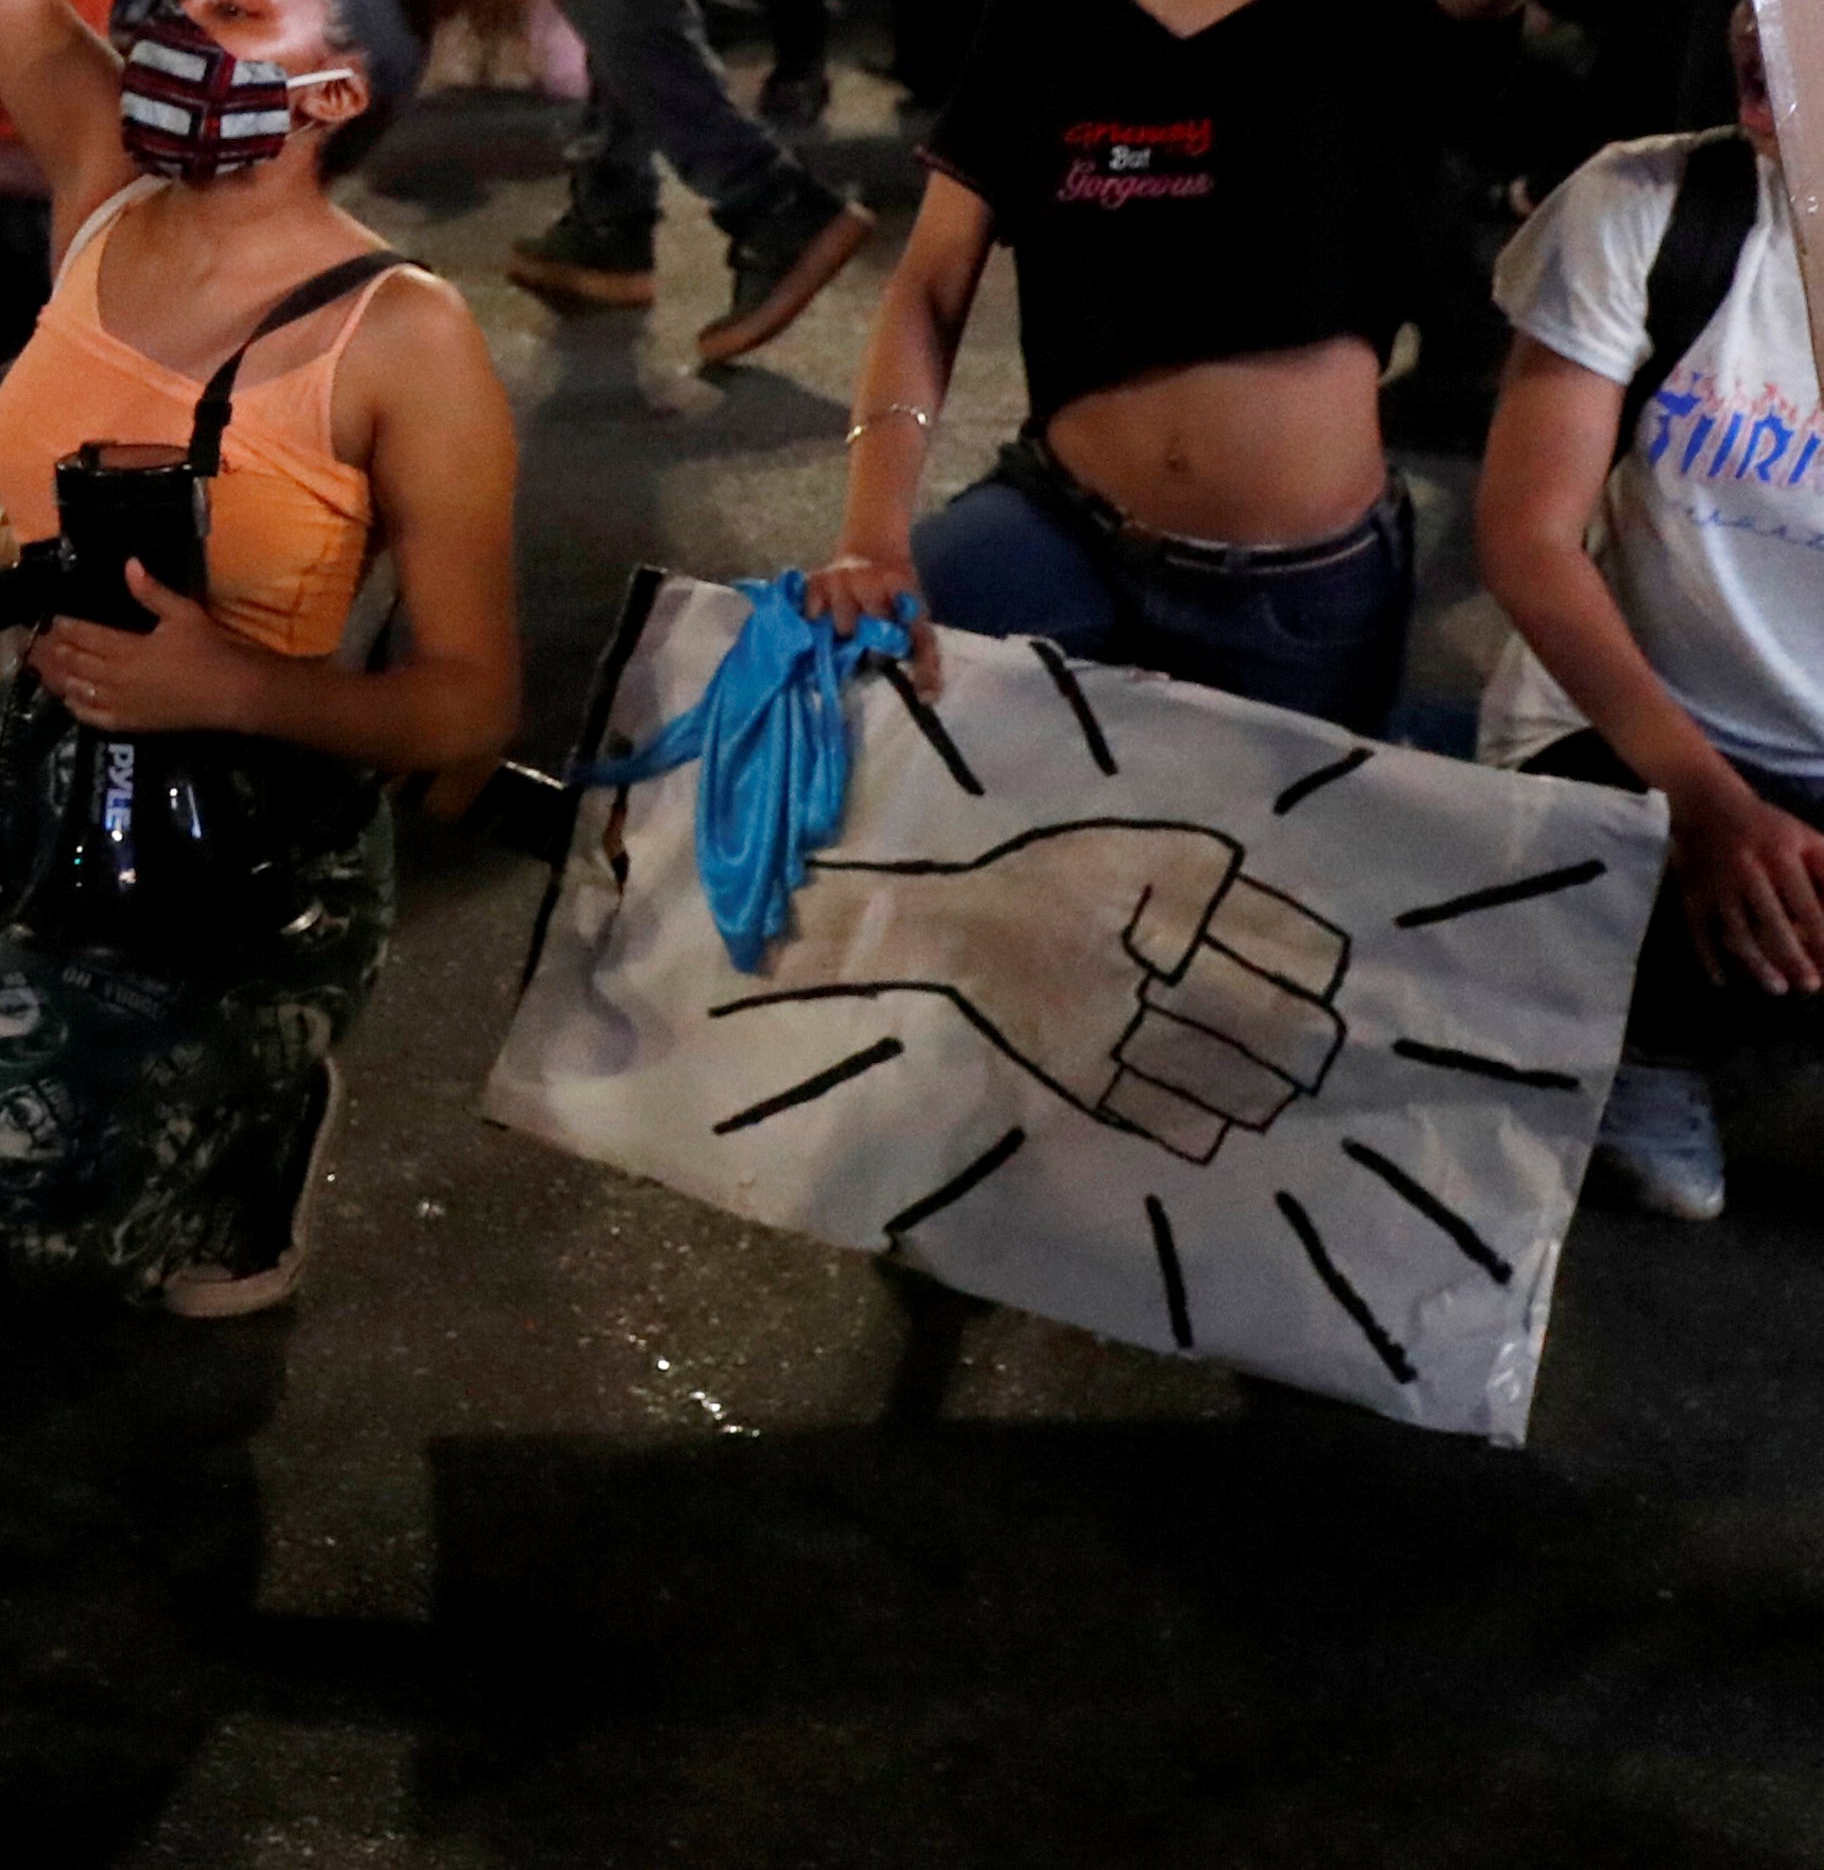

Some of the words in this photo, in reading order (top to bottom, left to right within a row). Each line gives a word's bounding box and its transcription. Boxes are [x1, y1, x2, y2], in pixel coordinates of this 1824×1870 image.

[1109, 143, 1151, 171] But
[1055, 158, 1215, 211] Gorgeous
[105, 742, 135, 832] PYLE
